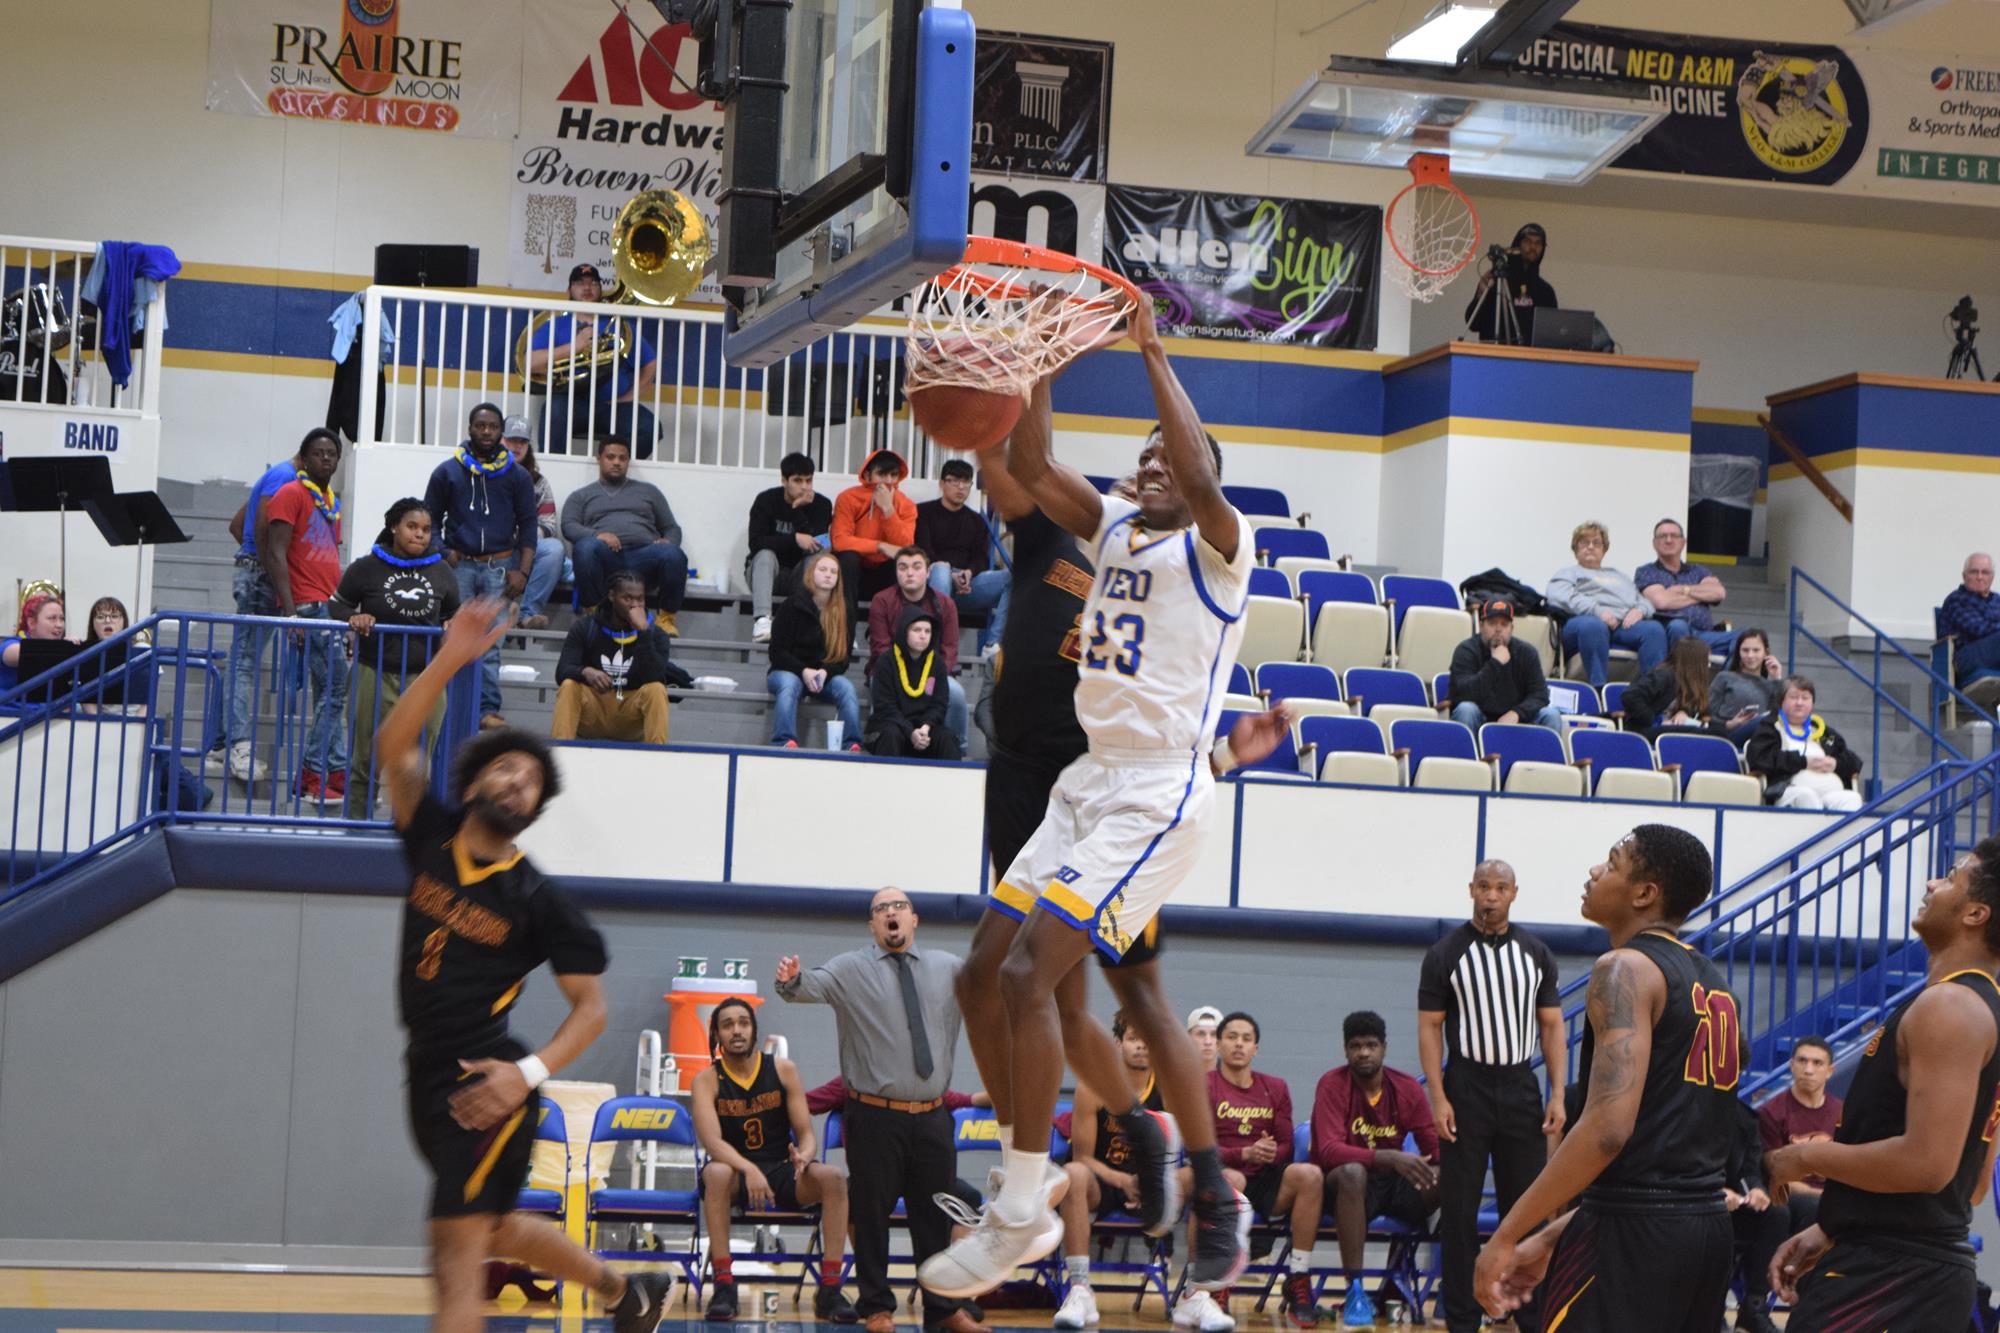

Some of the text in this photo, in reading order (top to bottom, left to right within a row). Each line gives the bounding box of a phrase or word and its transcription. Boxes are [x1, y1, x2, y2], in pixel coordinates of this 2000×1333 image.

[272, 22, 462, 96] PRAIRIE
[1626, 48, 1674, 80] NEO
[1680, 54, 1734, 86] A&M
[270, 66, 460, 101] SUN and MOON
[279, 93, 449, 128] CASINOS
[1908, 116, 1921, 132] &
[1924, 119, 1965, 138] Sports
[1014, 132, 1058, 151] PLLC
[991, 157, 1013, 166] AT
[1027, 158, 1071, 172] LAW
[1123, 199, 1354, 324] allen Sign
[1134, 267, 1233, 285] a Sign of Servic
[64, 421, 119, 452] BAND
[384, 571, 434, 596] HOLLISTER
[385, 592, 397, 609] LOS
[1086, 610, 1145, 677] 23
[611, 1107, 677, 1130] NEO
[1217, 1101, 1274, 1124] Cougars
[743, 1117, 764, 1150] 3
[959, 1119, 1000, 1141] NE
[1352, 1117, 1397, 1140] Cougars
